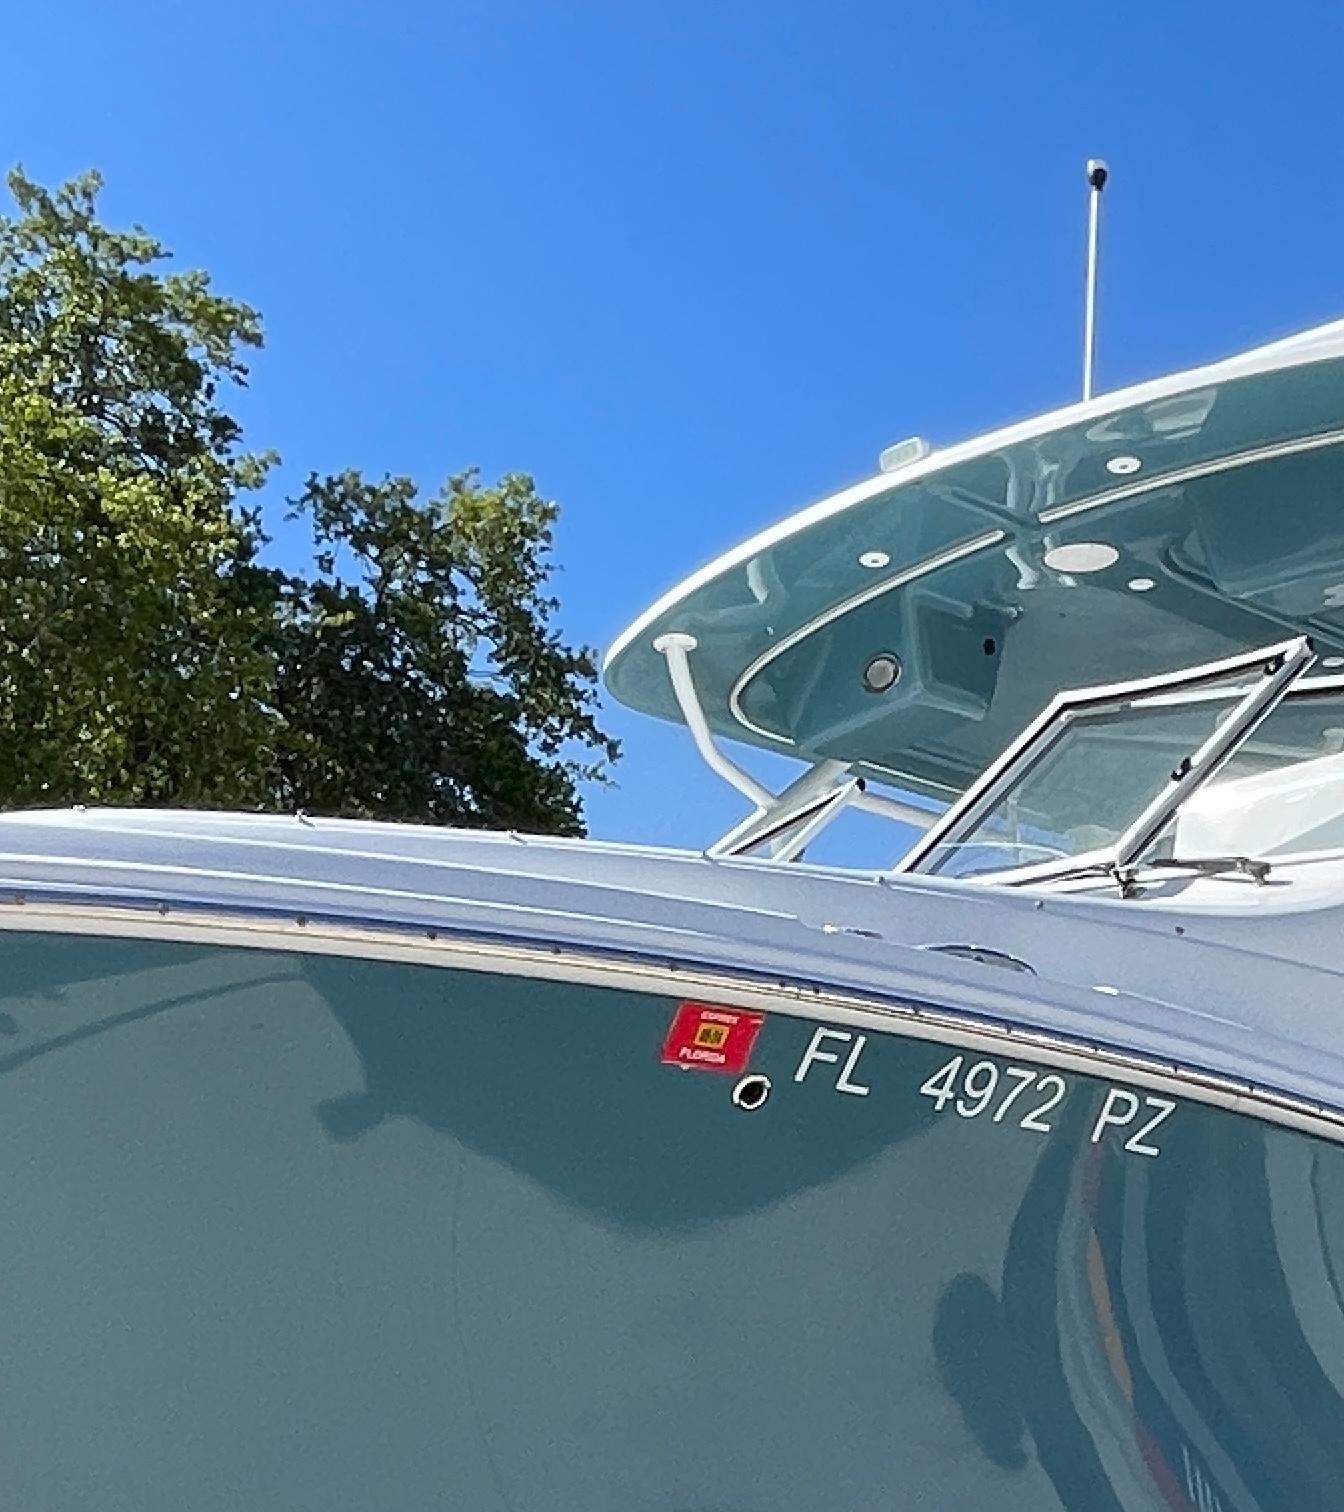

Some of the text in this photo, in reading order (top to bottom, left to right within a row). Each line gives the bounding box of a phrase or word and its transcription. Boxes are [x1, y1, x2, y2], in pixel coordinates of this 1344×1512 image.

[793, 1026, 1177, 1157] FL 4972 PZ
